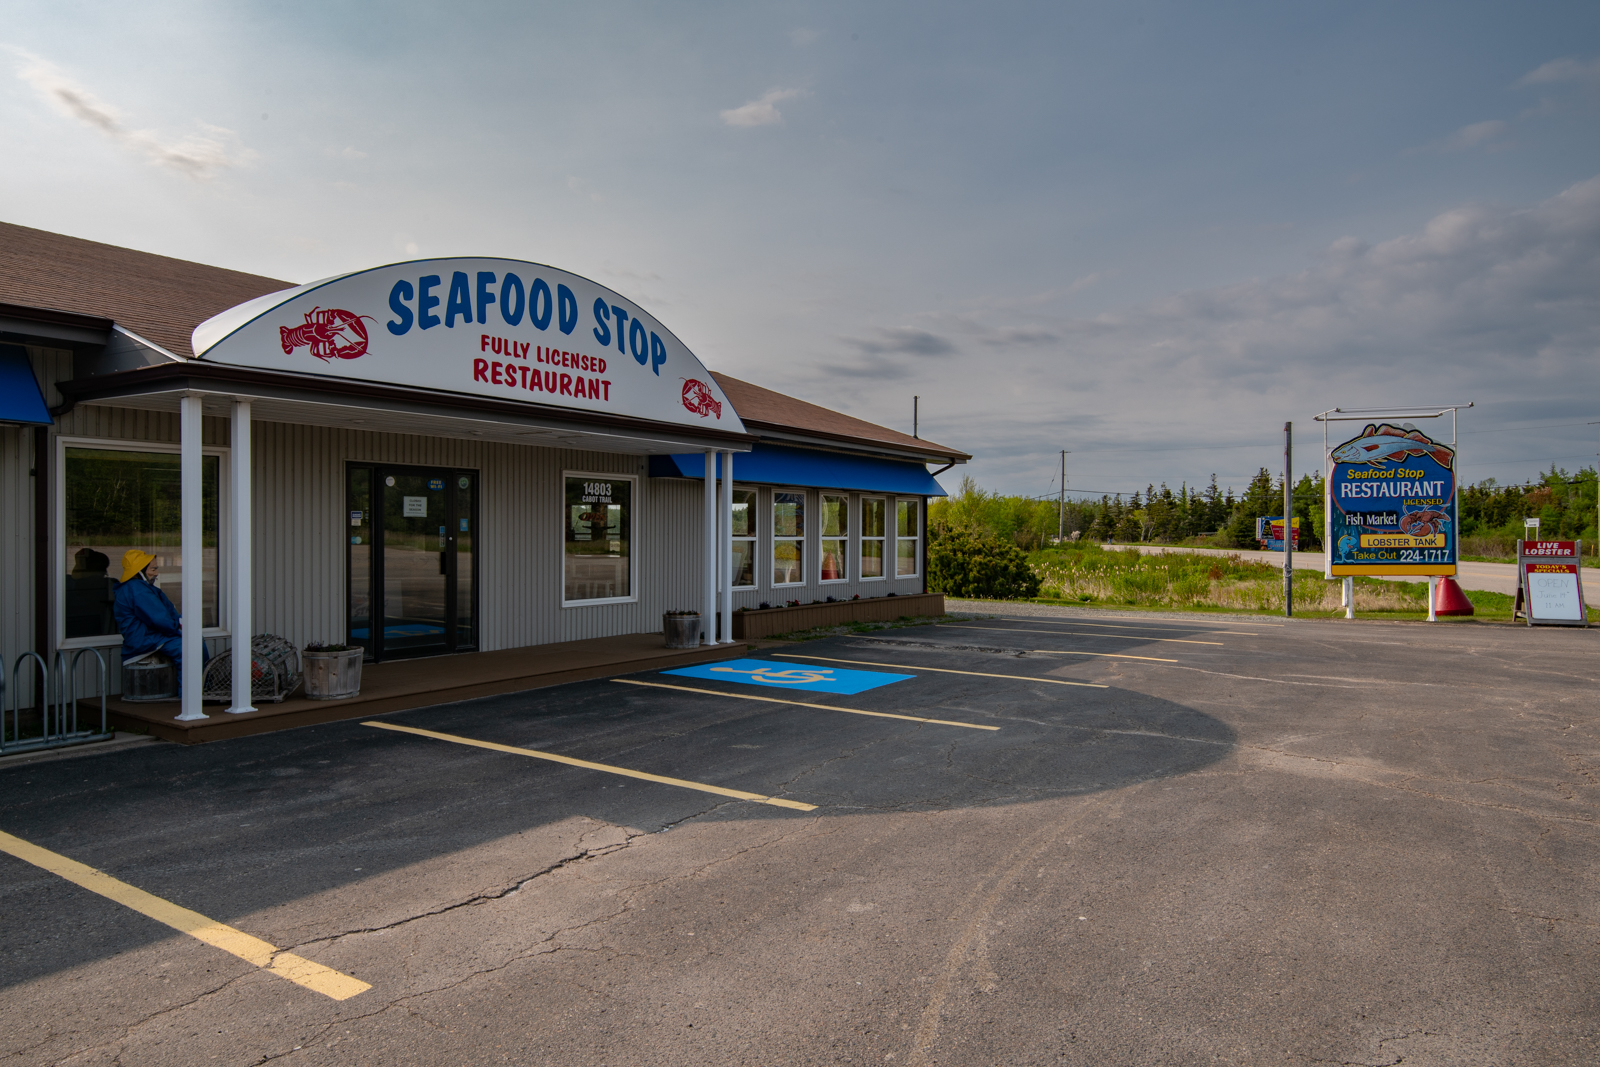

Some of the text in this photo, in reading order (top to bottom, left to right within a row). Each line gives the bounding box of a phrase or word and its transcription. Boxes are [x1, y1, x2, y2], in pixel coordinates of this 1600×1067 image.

[386, 271, 667, 376] SEAFOOD STOP
[480, 334, 607, 374] FULLY LICENSED
[473, 358, 612, 402] RESTAURANT
[1347, 468, 1425, 480] Seafood Stop
[583, 481, 612, 496] 14803
[1341, 480, 1445, 498] RESTAURANT
[582, 495, 598, 503] CABOT
[581, 512, 607, 522] OPEN
[1345, 512, 1397, 526] Fish Market
[1367, 538, 1437, 547] LOBSTER TANK
[1352, 550, 1450, 562] Take Out 224-1717
[1525, 548, 1571, 556] LOBSTER
[1537, 578, 1569, 588] OPEN
[1536, 590, 1557, 598] June
